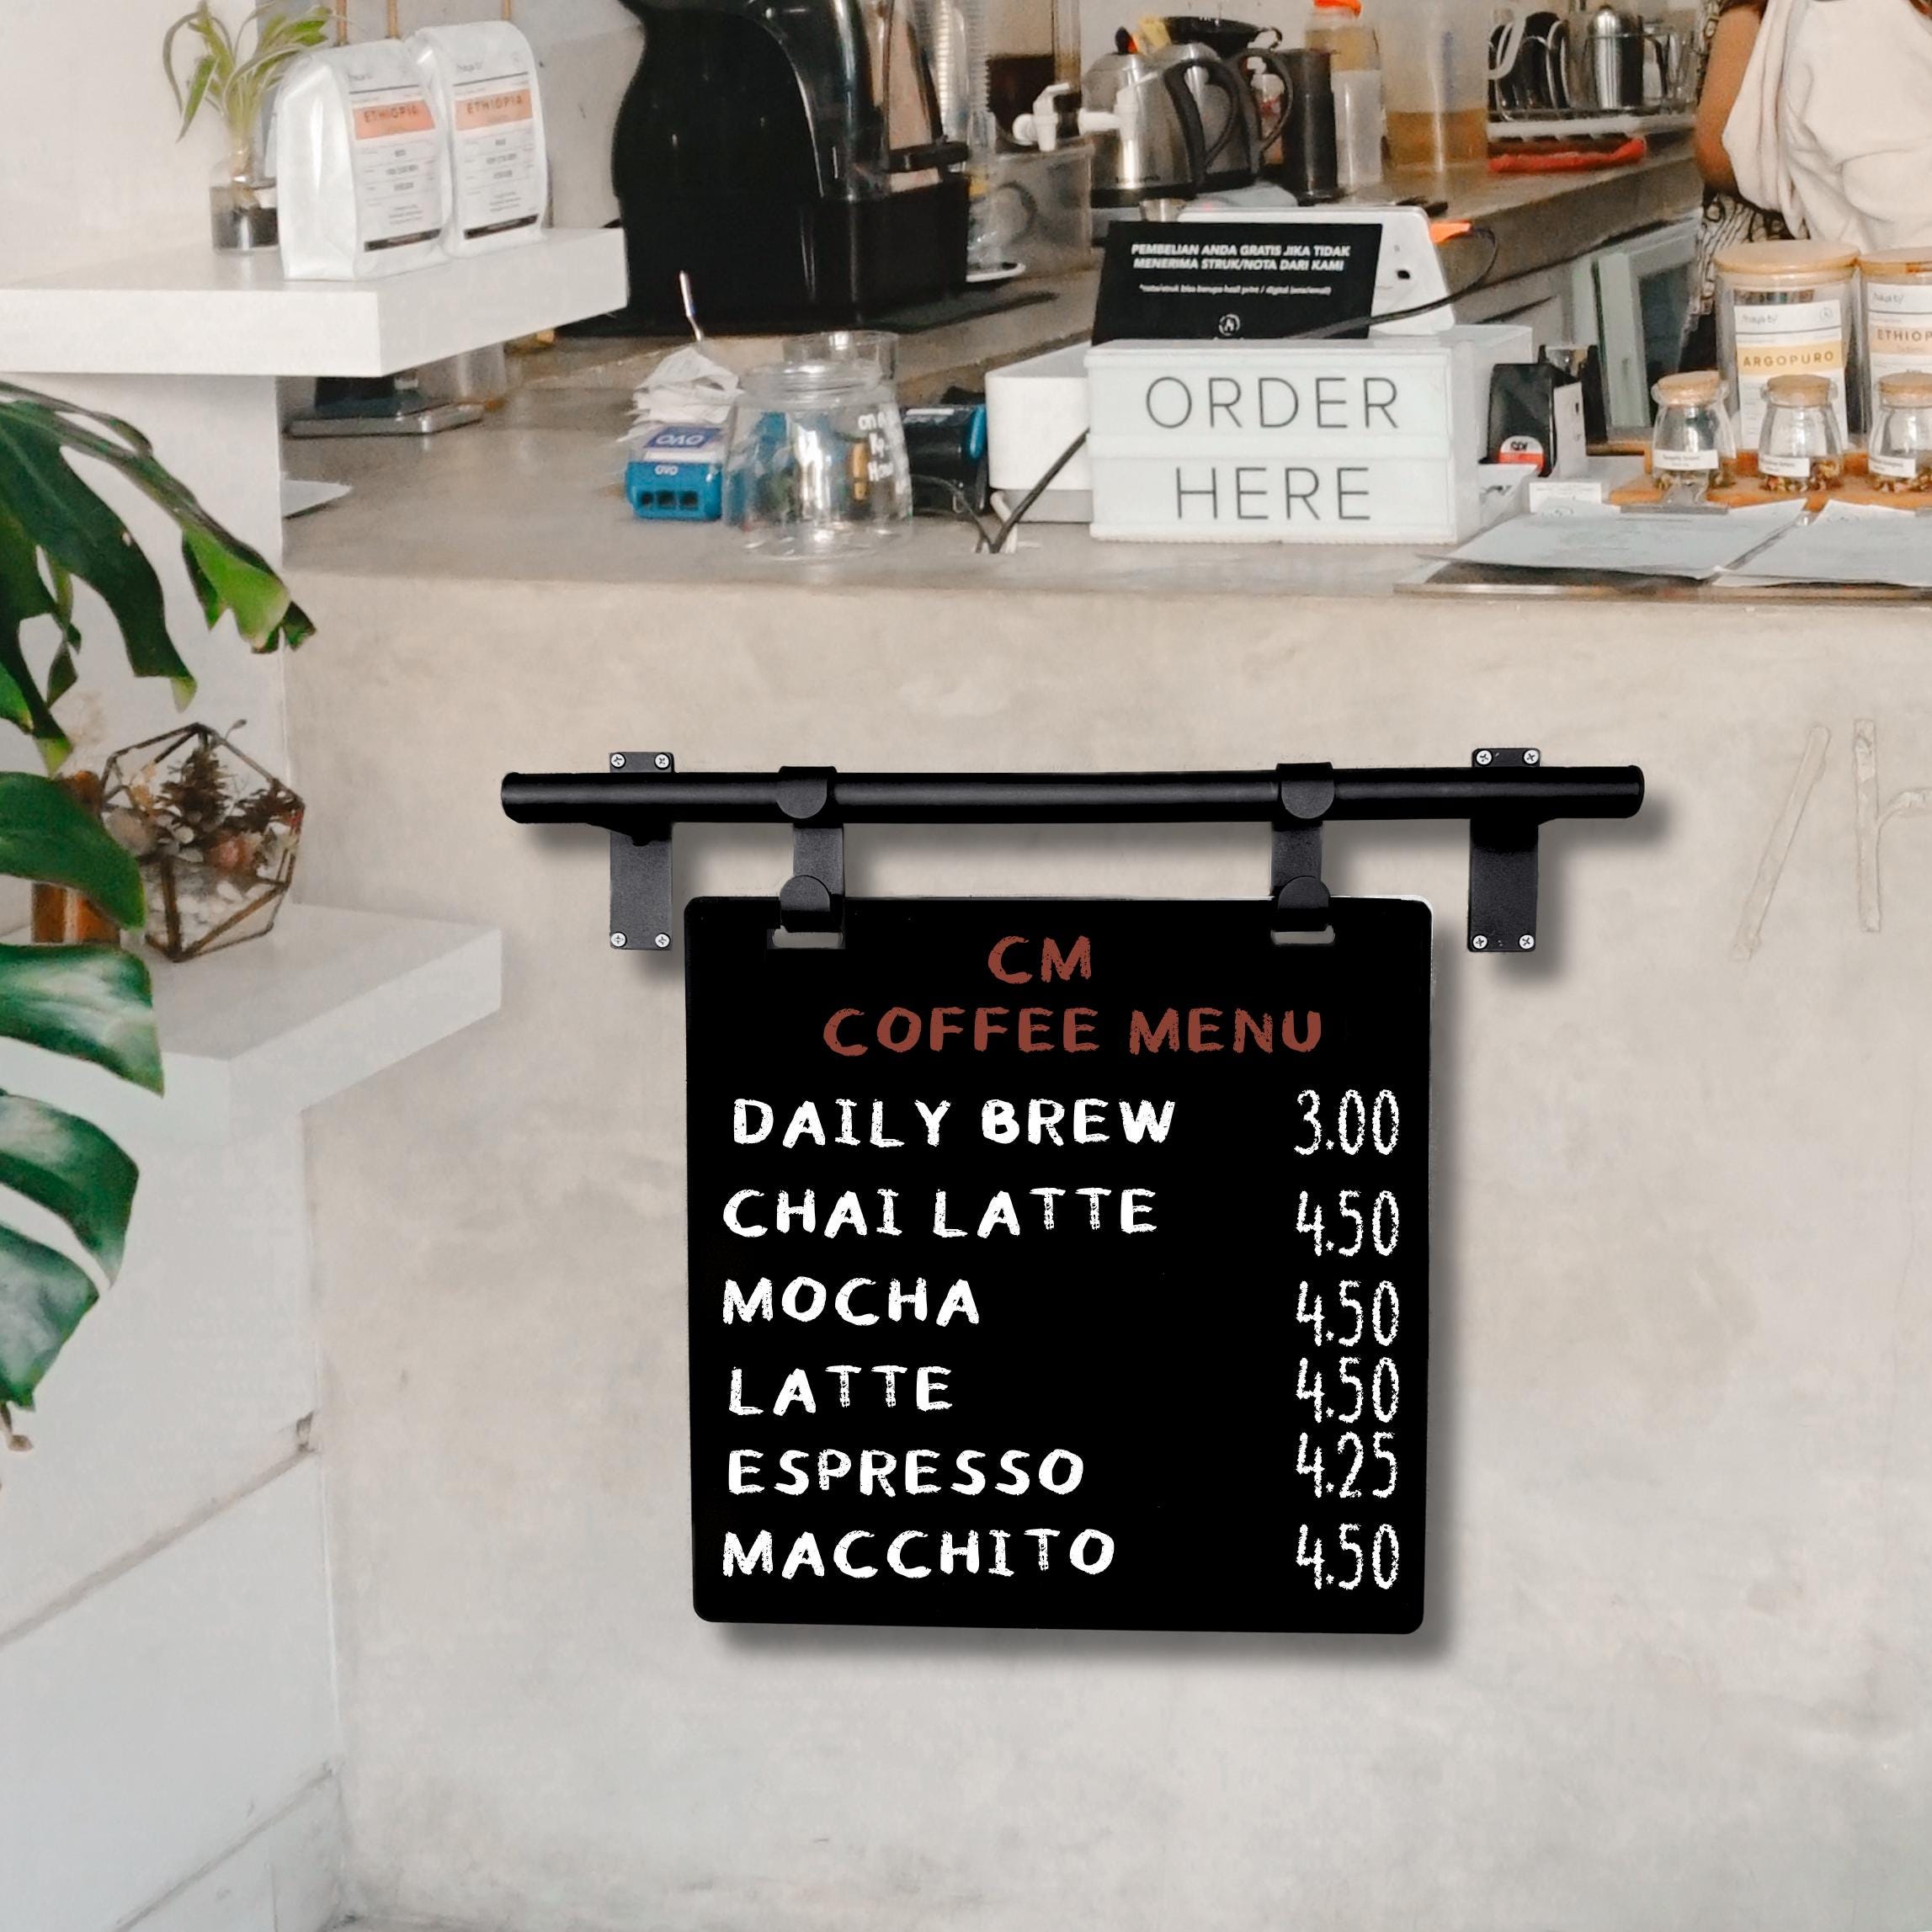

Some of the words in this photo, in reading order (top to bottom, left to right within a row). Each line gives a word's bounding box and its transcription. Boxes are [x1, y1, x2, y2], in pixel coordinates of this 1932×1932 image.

[1131, 243, 1199, 255] PEMBELIAN
[1201, 244, 1237, 255] ANDA
[1240, 245, 1281, 256] GRATIS
[1283, 245, 1311, 256] JIKA
[1313, 245, 1350, 257] TIDAK
[1133, 258, 1199, 269] MENERIMA
[1201, 258, 1278, 270] STRUK/NOTA
[1280, 259, 1309, 270] DARI
[1311, 260, 1344, 271] KAMI
[1743, 350, 1834, 367] ARGOPURO
[1147, 376, 1399, 430] ORDER
[1176, 467, 1371, 521] HERE
[988, 935, 1092, 984] CM
[824, 1007, 1100, 1056] COFFEE
[1130, 1008, 1323, 1056] MENU
[734, 1098, 952, 1149] DAILY
[982, 1098, 1177, 1147] BREW
[1295, 1089, 1401, 1156] 3.00
[723, 1188, 904, 1239] CHAI
[934, 1187, 1159, 1239] LATTE
[1296, 1190, 1401, 1258] 4.50
[723, 1276, 982, 1328] MOCHA
[1296, 1280, 1401, 1348] 4.50
[729, 1365, 954, 1417] LATTE
[1296, 1357, 1401, 1424] 4.50
[729, 1448, 1085, 1498] ESPRESSO
[1296, 1431, 1399, 1499] 4.25
[723, 1528, 1116, 1581] MACCHITO
[1296, 1524, 1401, 1591] 4.50
